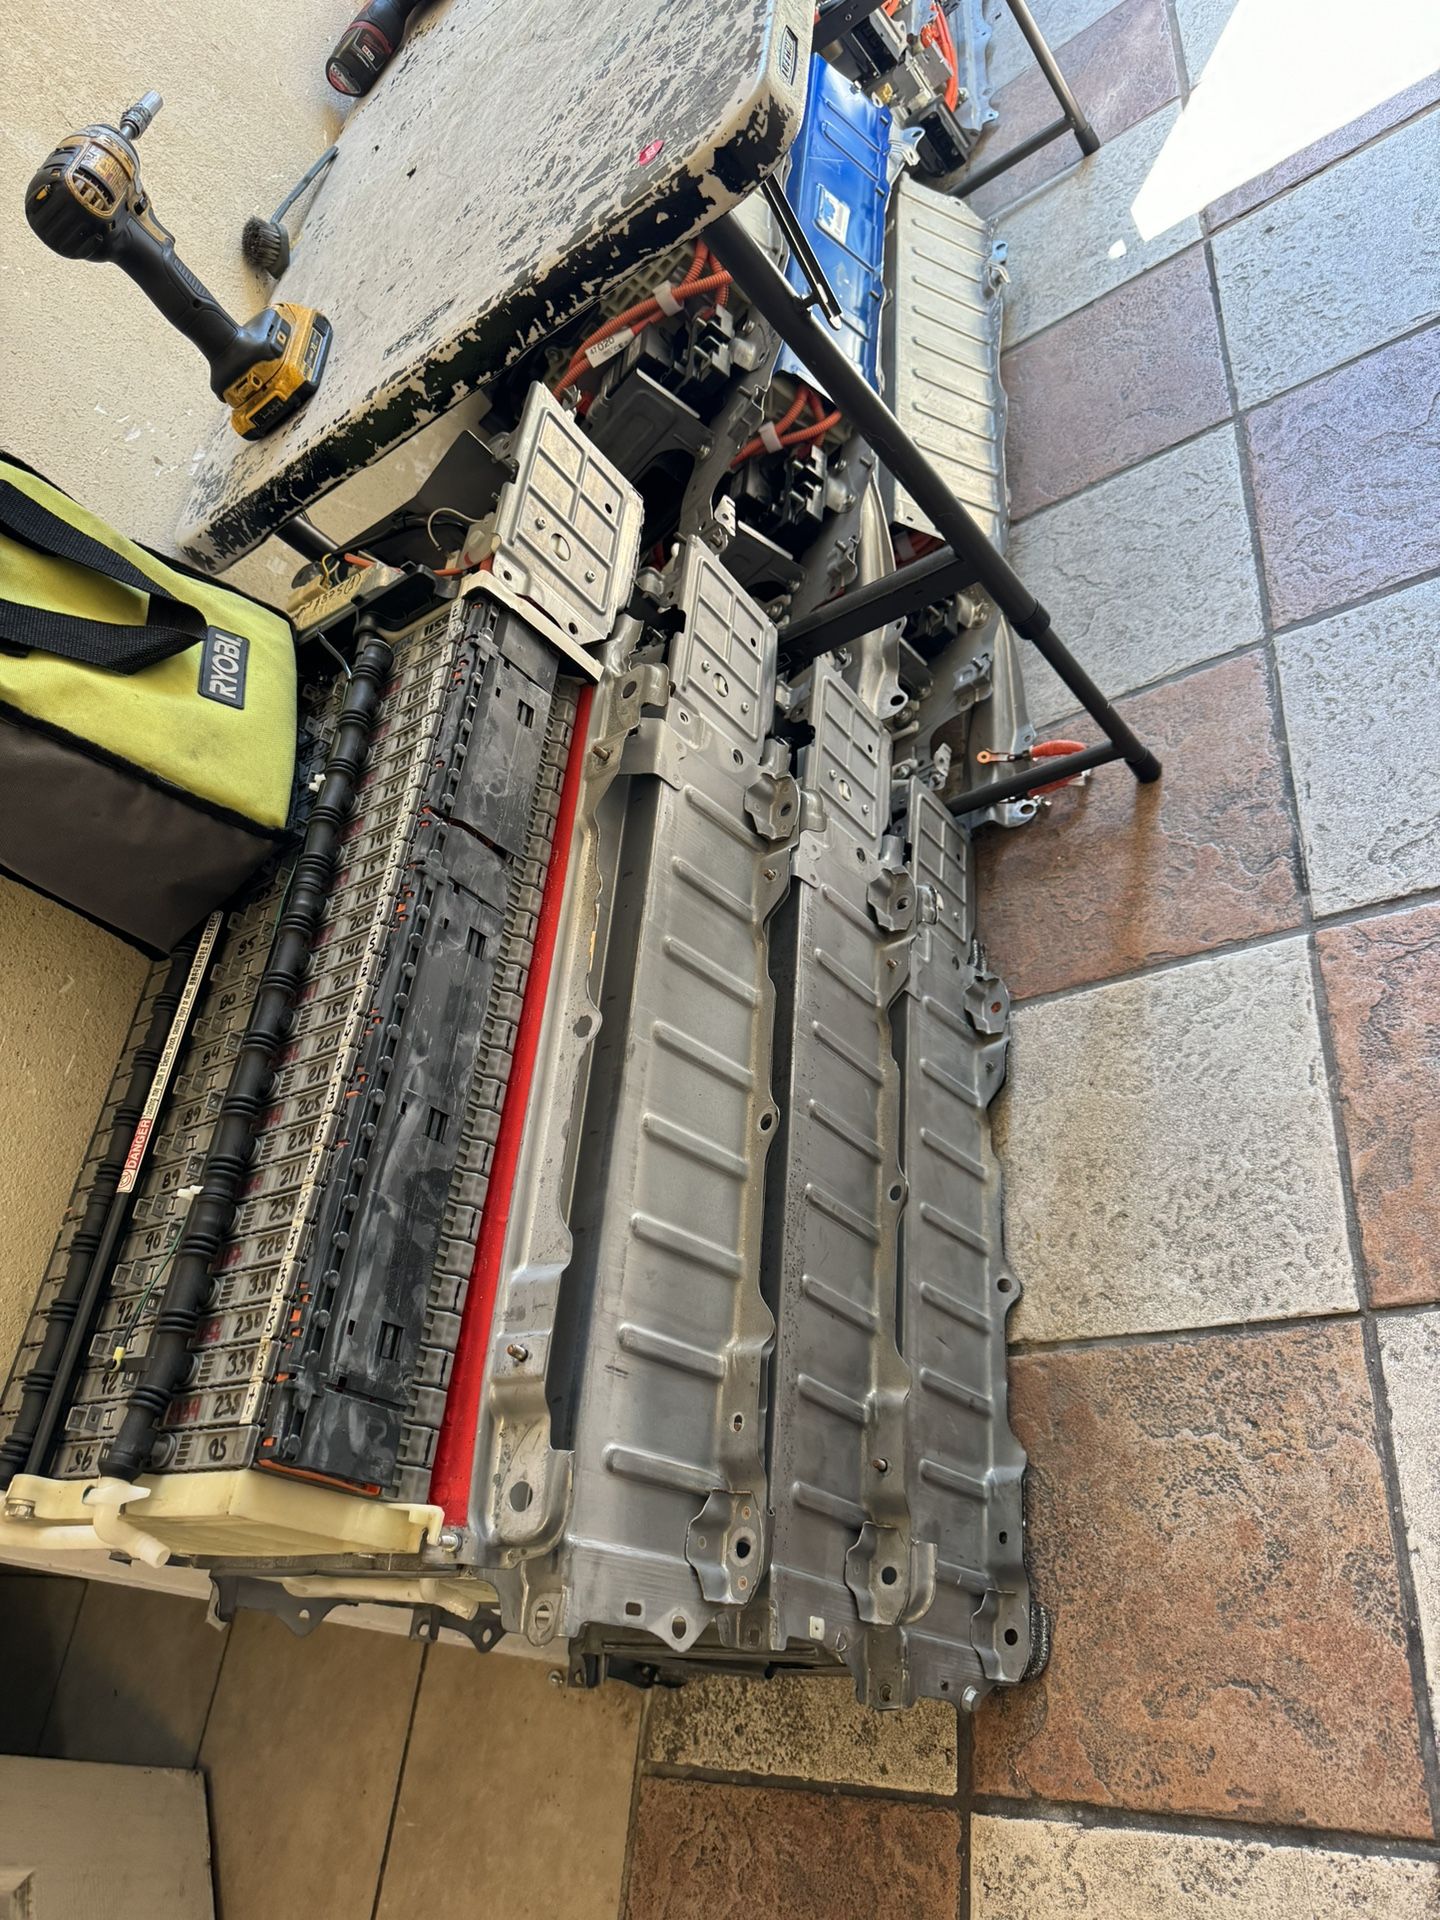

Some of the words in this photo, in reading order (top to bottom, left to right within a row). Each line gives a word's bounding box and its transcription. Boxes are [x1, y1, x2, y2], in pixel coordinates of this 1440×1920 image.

[316, 1030, 341, 1053] 201
[127, 1119, 151, 1169] DANGER
[287, 1125, 316, 1151] 224
[279, 1162, 302, 1187] 211
[145, 1230, 162, 1253] 90
